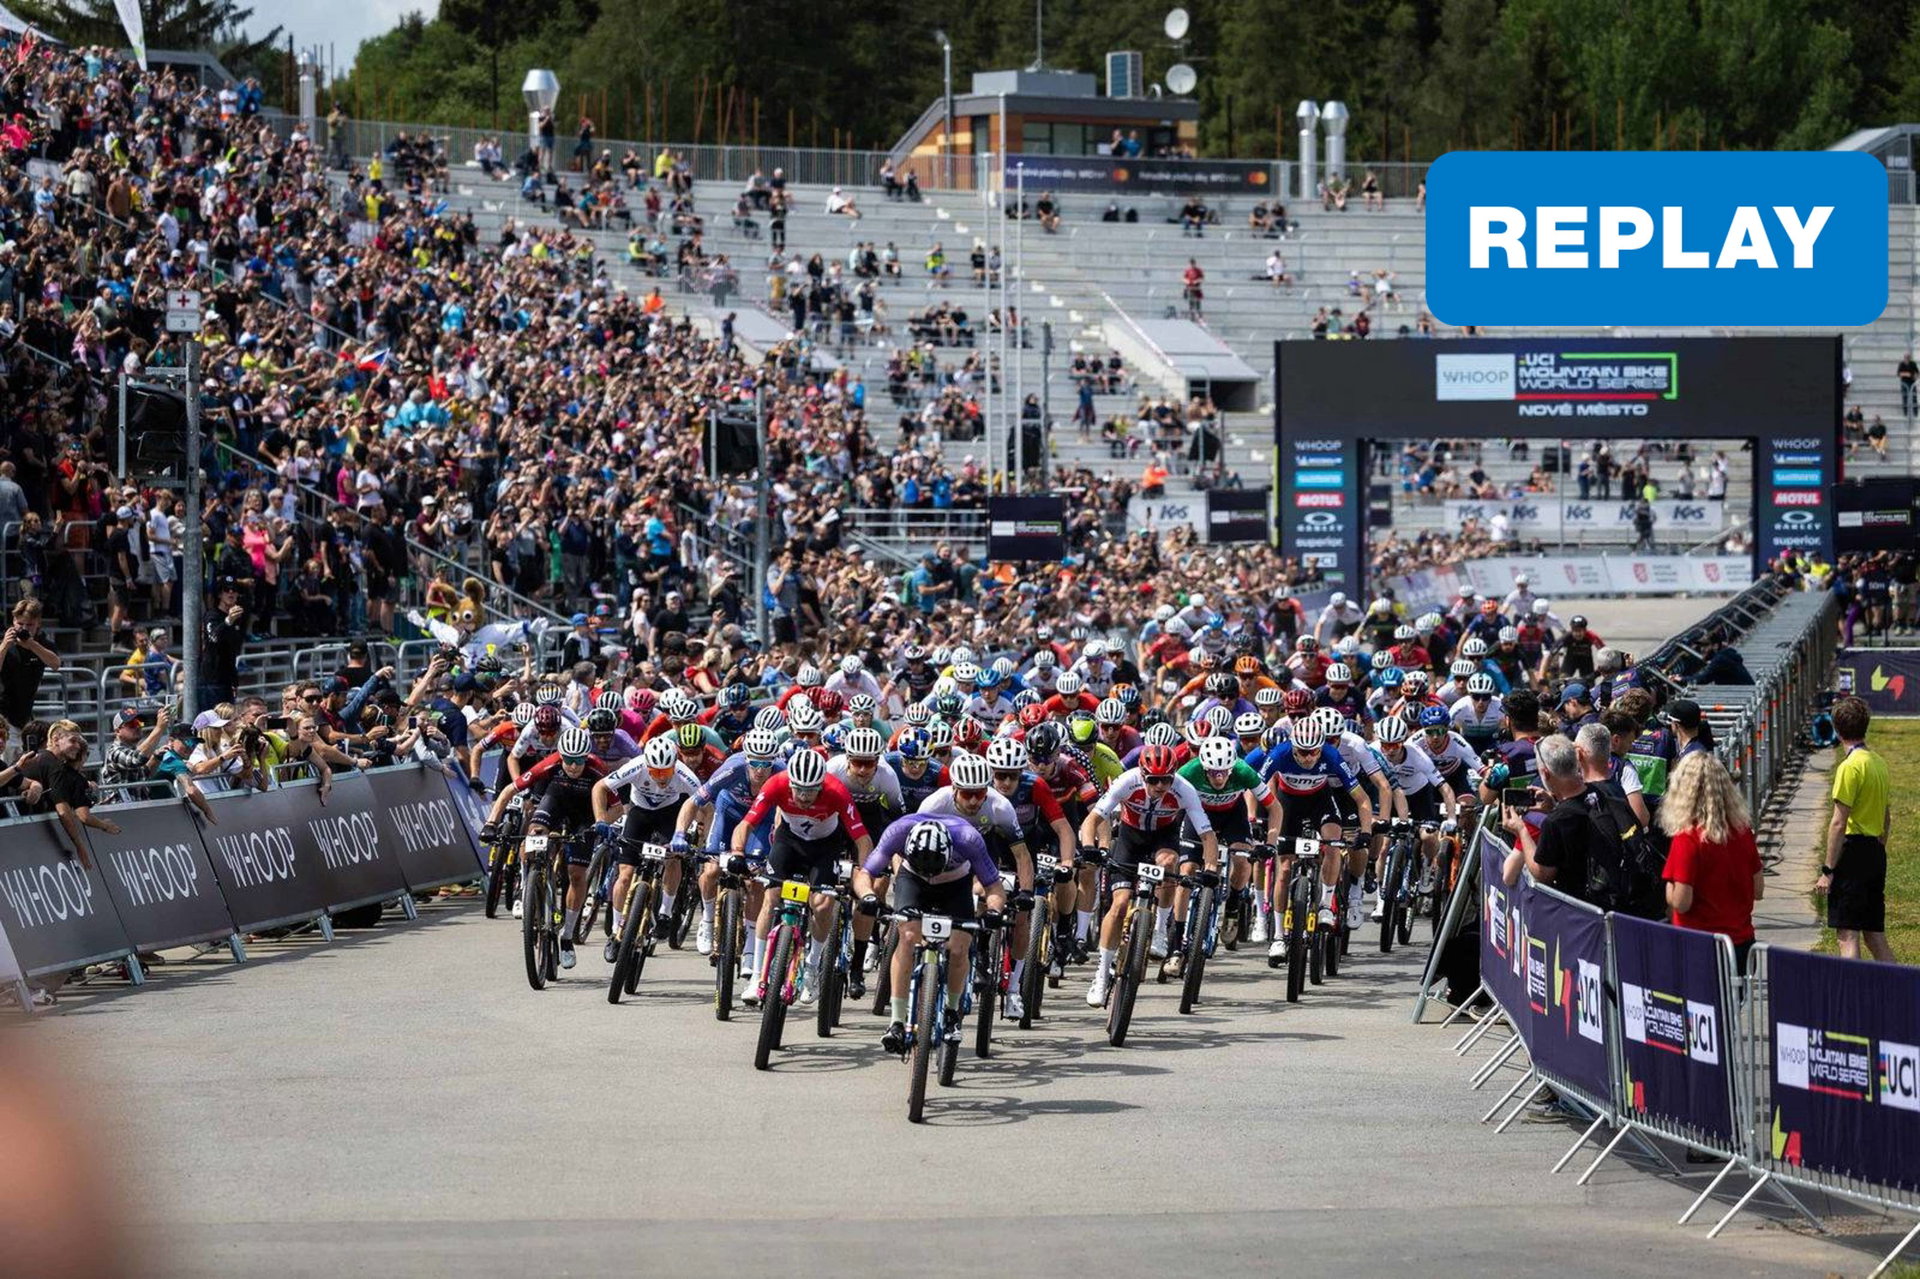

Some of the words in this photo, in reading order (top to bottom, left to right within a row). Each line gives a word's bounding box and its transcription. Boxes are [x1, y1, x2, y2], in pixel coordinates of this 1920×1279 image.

[1526, 353, 1555, 367] UCI
[1442, 370, 1510, 385] WHOOP
[1519, 366, 1620, 379] MOUNTAIN
[1623, 366, 1668, 379] BIKE
[1519, 378, 1594, 390] WORLD
[1597, 378, 1669, 390] SERIES
[1519, 402, 1574, 417] NOVÉ
[1772, 439, 1821, 450] WHOOP
[1775, 491, 1820, 505] MOTUL
[389, 799, 455, 854] WHOOP
[309, 812, 379, 870] WHOOP
[1303, 842, 1312, 852] 5
[645, 846, 663, 855] 16
[217, 827, 296, 890] WHOOP
[110, 844, 200, 907] WHOOP
[1141, 865, 1161, 877] 40
[0, 860, 94, 930] WHOOP
[791, 886, 798, 899] 1
[931, 921, 942, 934] 9
[1692, 1012, 1714, 1054] UCI
[1887, 1053, 1919, 1100] UCI
